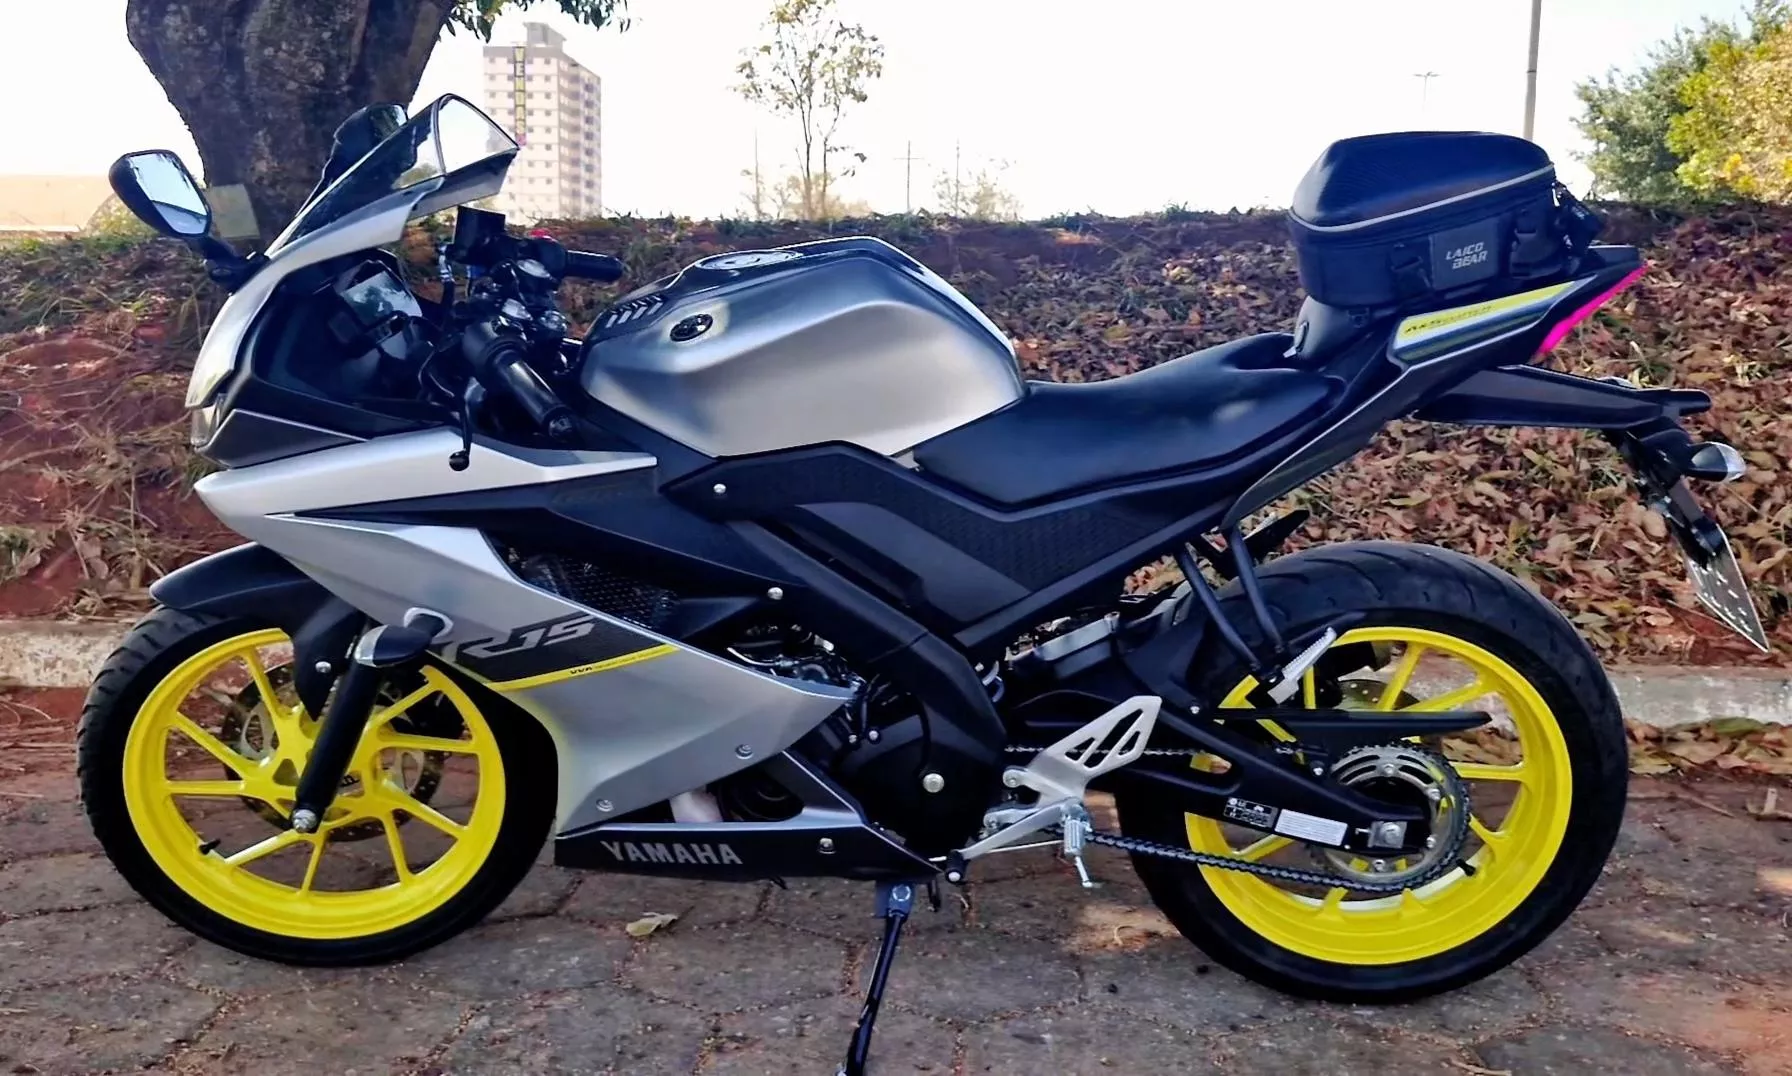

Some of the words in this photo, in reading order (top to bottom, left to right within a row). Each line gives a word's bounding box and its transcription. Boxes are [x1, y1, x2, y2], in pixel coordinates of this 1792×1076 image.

[1446, 241, 1485, 260] LAICO
[1452, 250, 1488, 270] BEAR
[600, 840, 743, 865] YAMAHA
